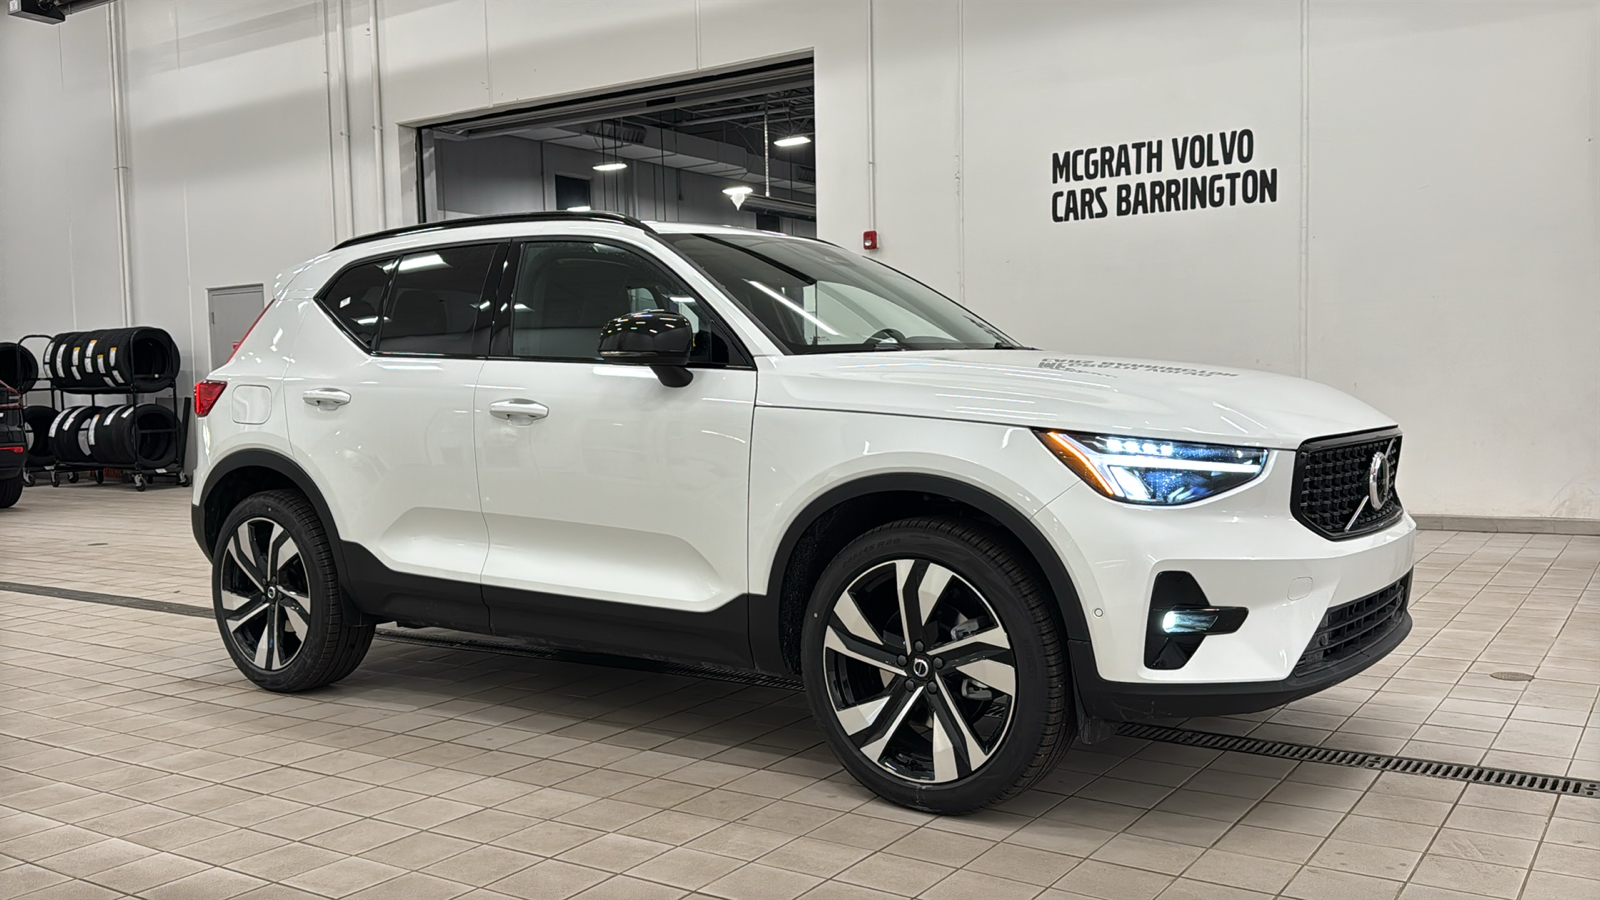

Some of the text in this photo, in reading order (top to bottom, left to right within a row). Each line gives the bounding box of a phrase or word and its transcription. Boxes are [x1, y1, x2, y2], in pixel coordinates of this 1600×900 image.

[1052, 128, 1254, 184] MCGRATH VOLVO
[1052, 168, 1278, 223] CARS BARRINGTON
